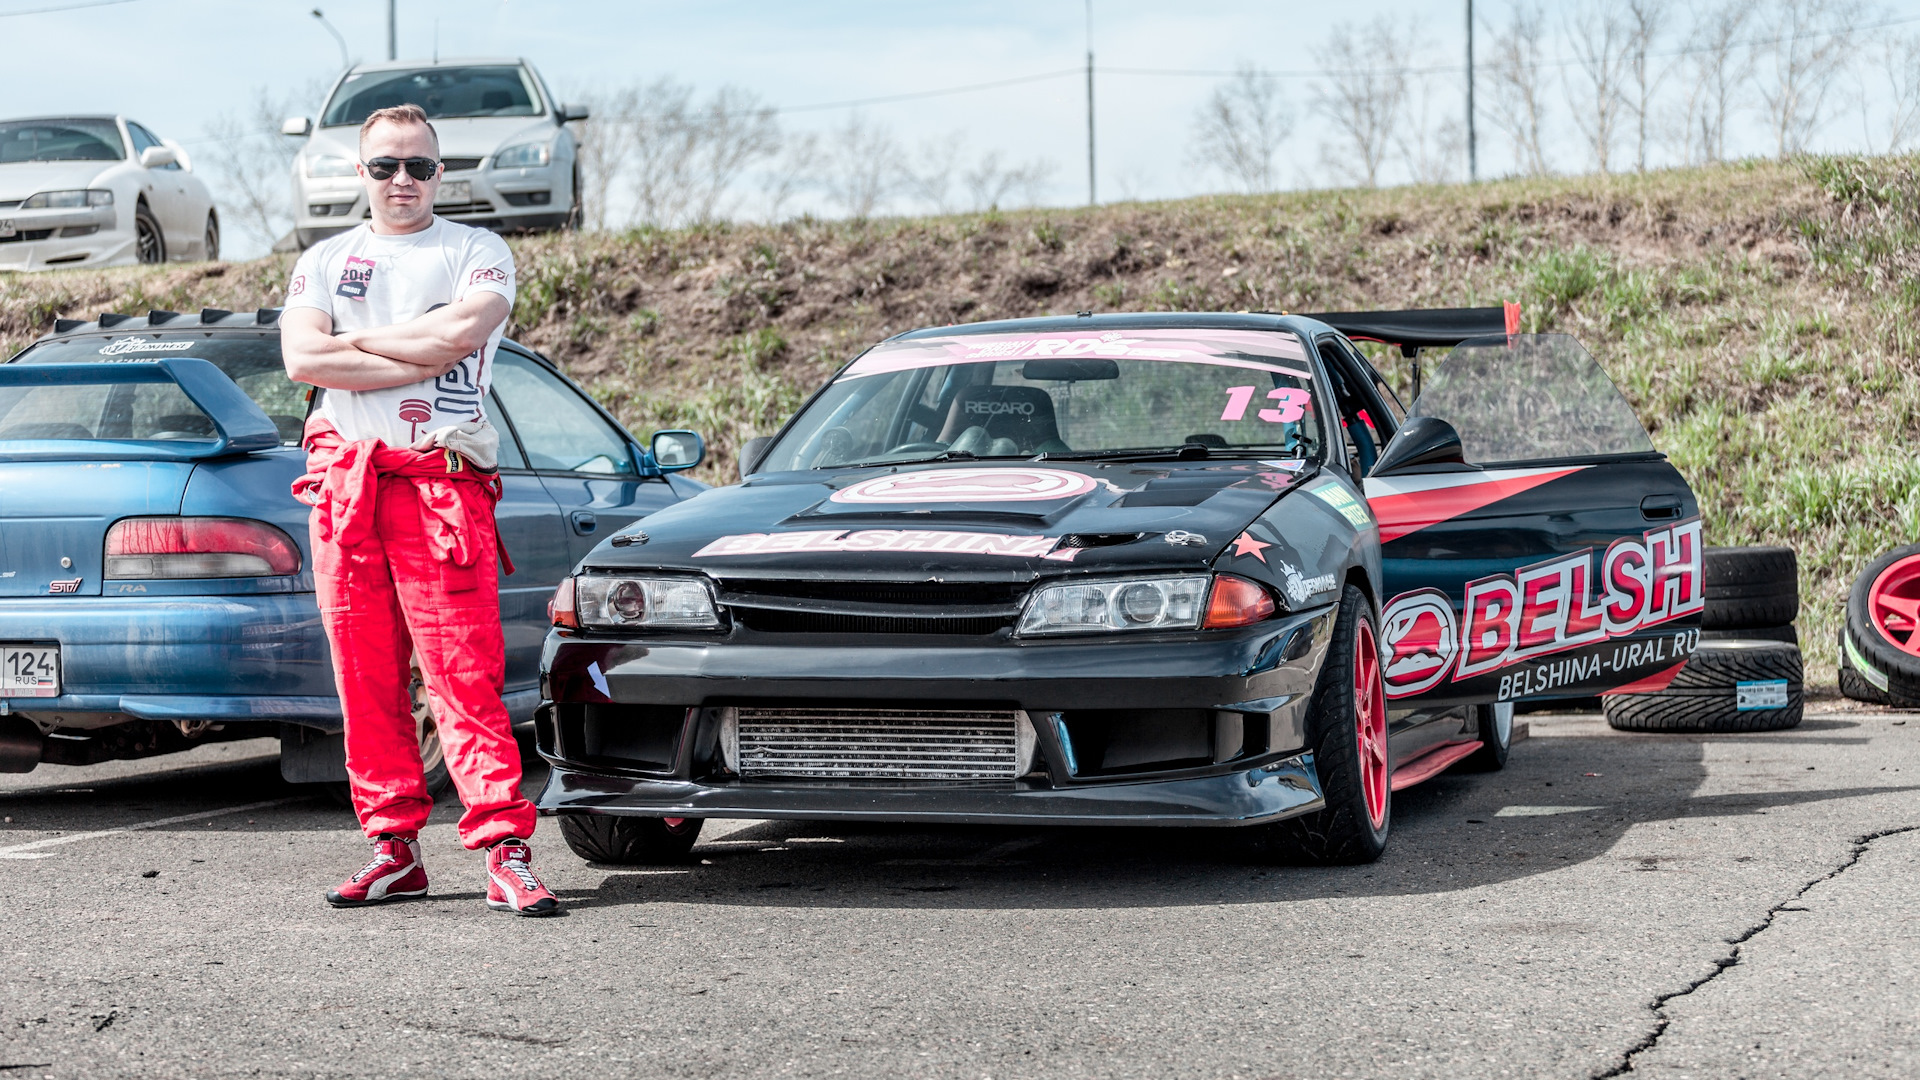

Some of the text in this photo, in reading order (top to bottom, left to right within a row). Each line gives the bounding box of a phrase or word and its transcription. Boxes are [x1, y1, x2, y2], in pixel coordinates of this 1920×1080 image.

[341, 268, 373, 281] 2019
[1023, 339, 1144, 356] RDS
[965, 401, 1035, 415] RECARO
[1220, 385, 1311, 423] 13
[118, 584, 147, 593] RA
[1456, 520, 1704, 678] BELSH
[7, 652, 49, 676] 124
[15, 676, 37, 685] RUS
